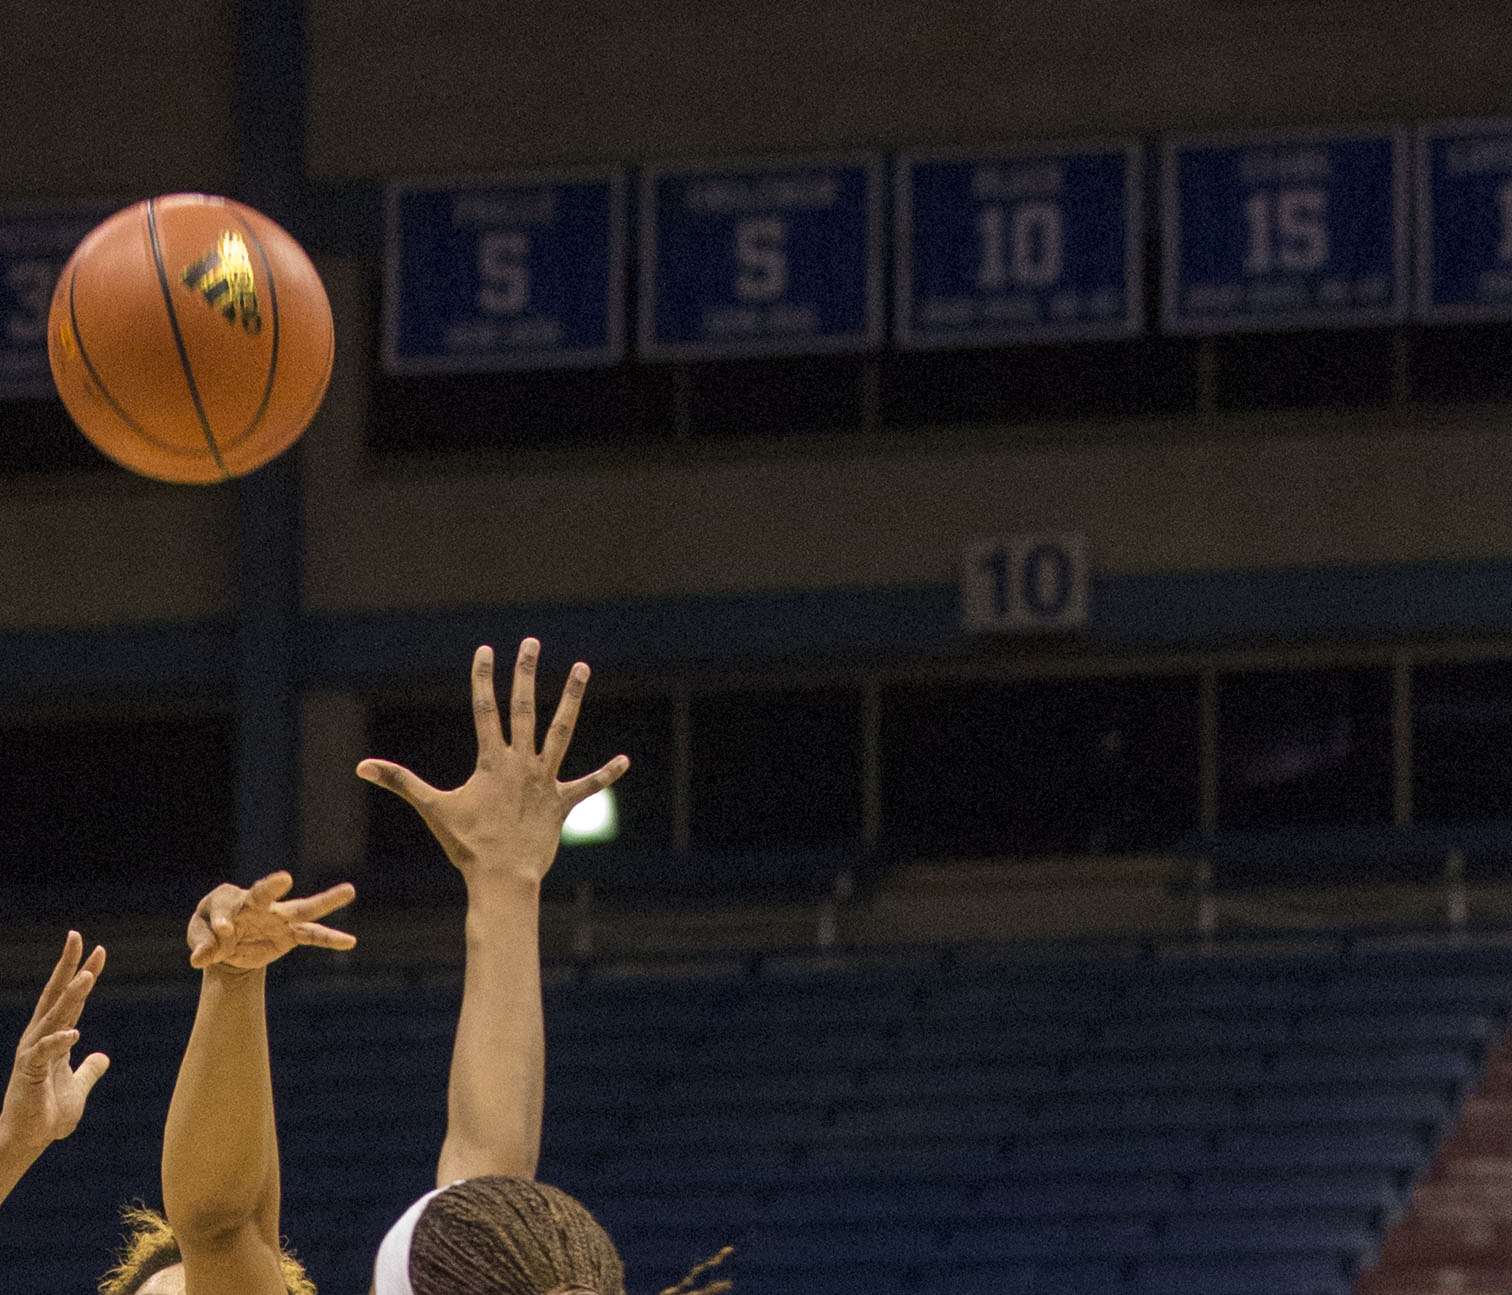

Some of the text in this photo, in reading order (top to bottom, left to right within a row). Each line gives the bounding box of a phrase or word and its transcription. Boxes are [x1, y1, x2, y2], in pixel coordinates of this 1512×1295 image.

[978, 202, 1065, 288] 10
[1243, 188, 1329, 276] 15
[6, 261, 50, 342] 3
[980, 543, 1072, 618] 10
